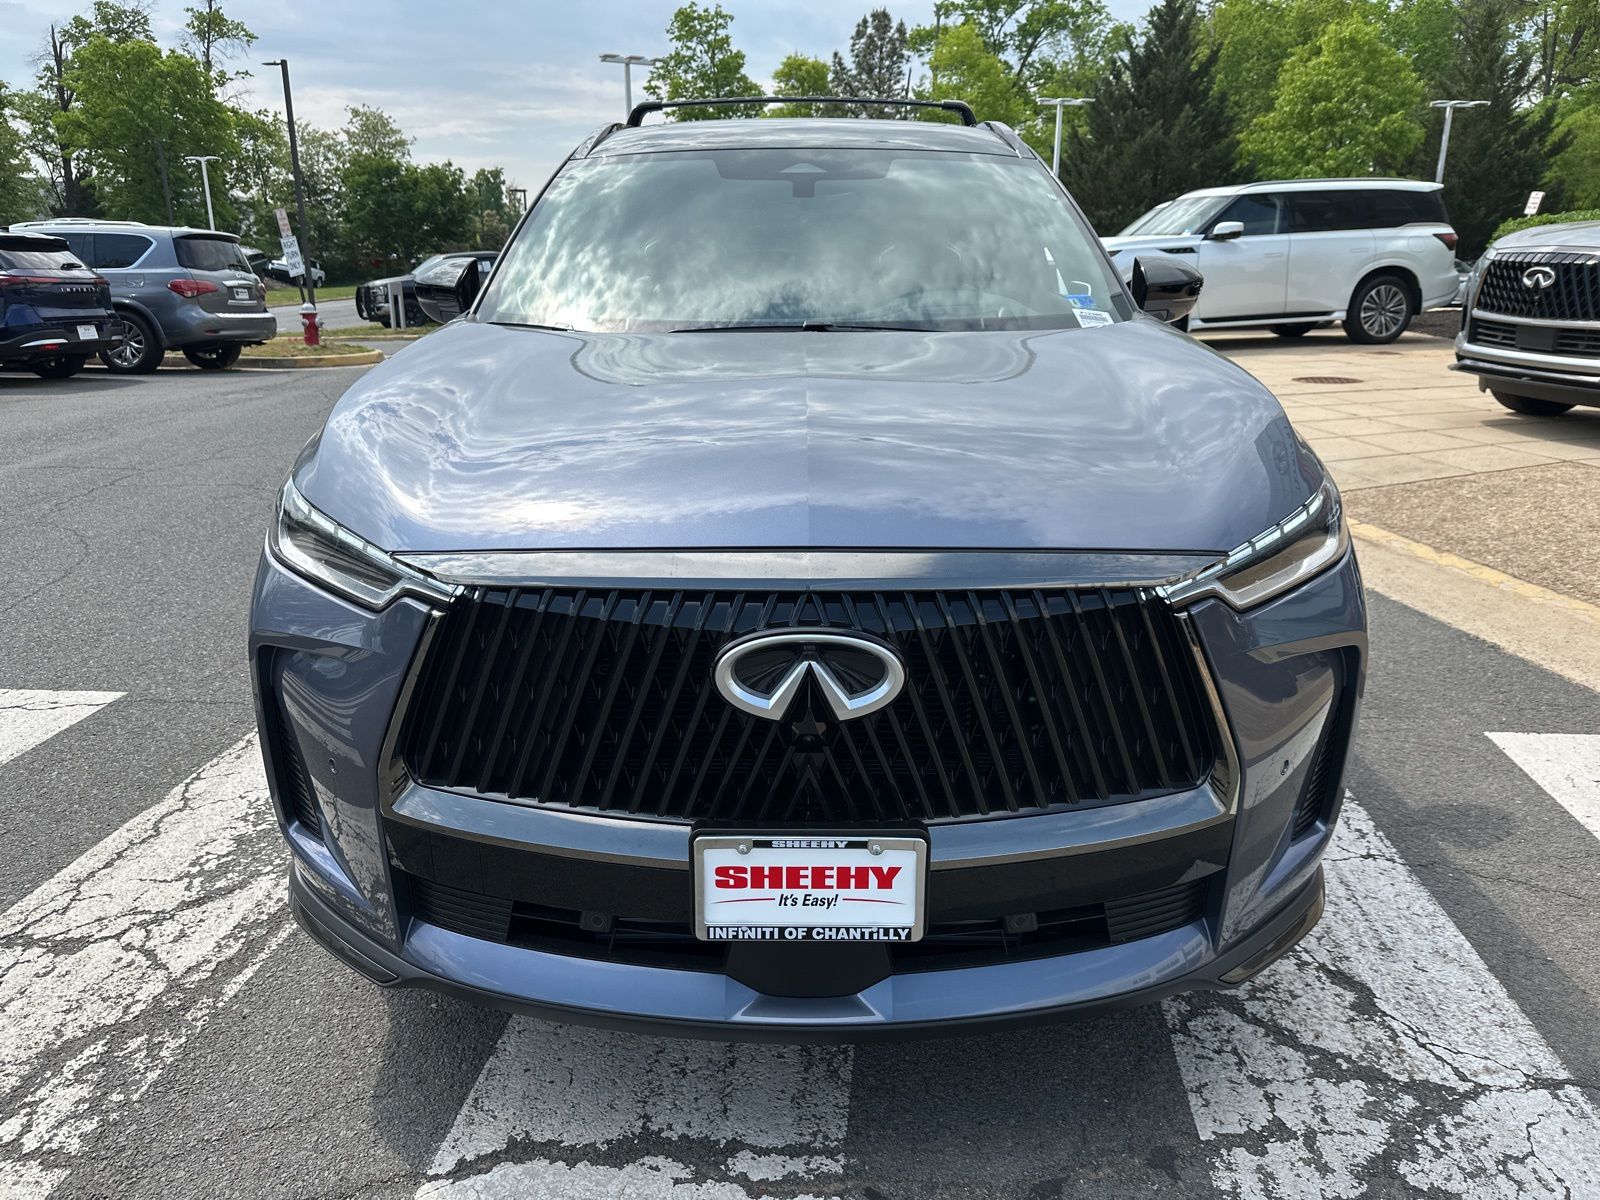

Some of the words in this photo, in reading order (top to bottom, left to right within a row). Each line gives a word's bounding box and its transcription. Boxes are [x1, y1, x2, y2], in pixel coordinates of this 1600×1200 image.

[283, 240, 296, 249] RIGHT
[286, 251, 299, 259] TURN
[289, 261, 301, 270] ONLY
[771, 840, 849, 848] SHEEHY
[714, 866, 902, 890] SHEEHY
[778, 894, 798, 907] It's
[802, 894, 838, 909] Easy!
[709, 927, 779, 940] INFINITI
[785, 927, 807, 940] OF
[812, 927, 910, 940] CHANTILLY
